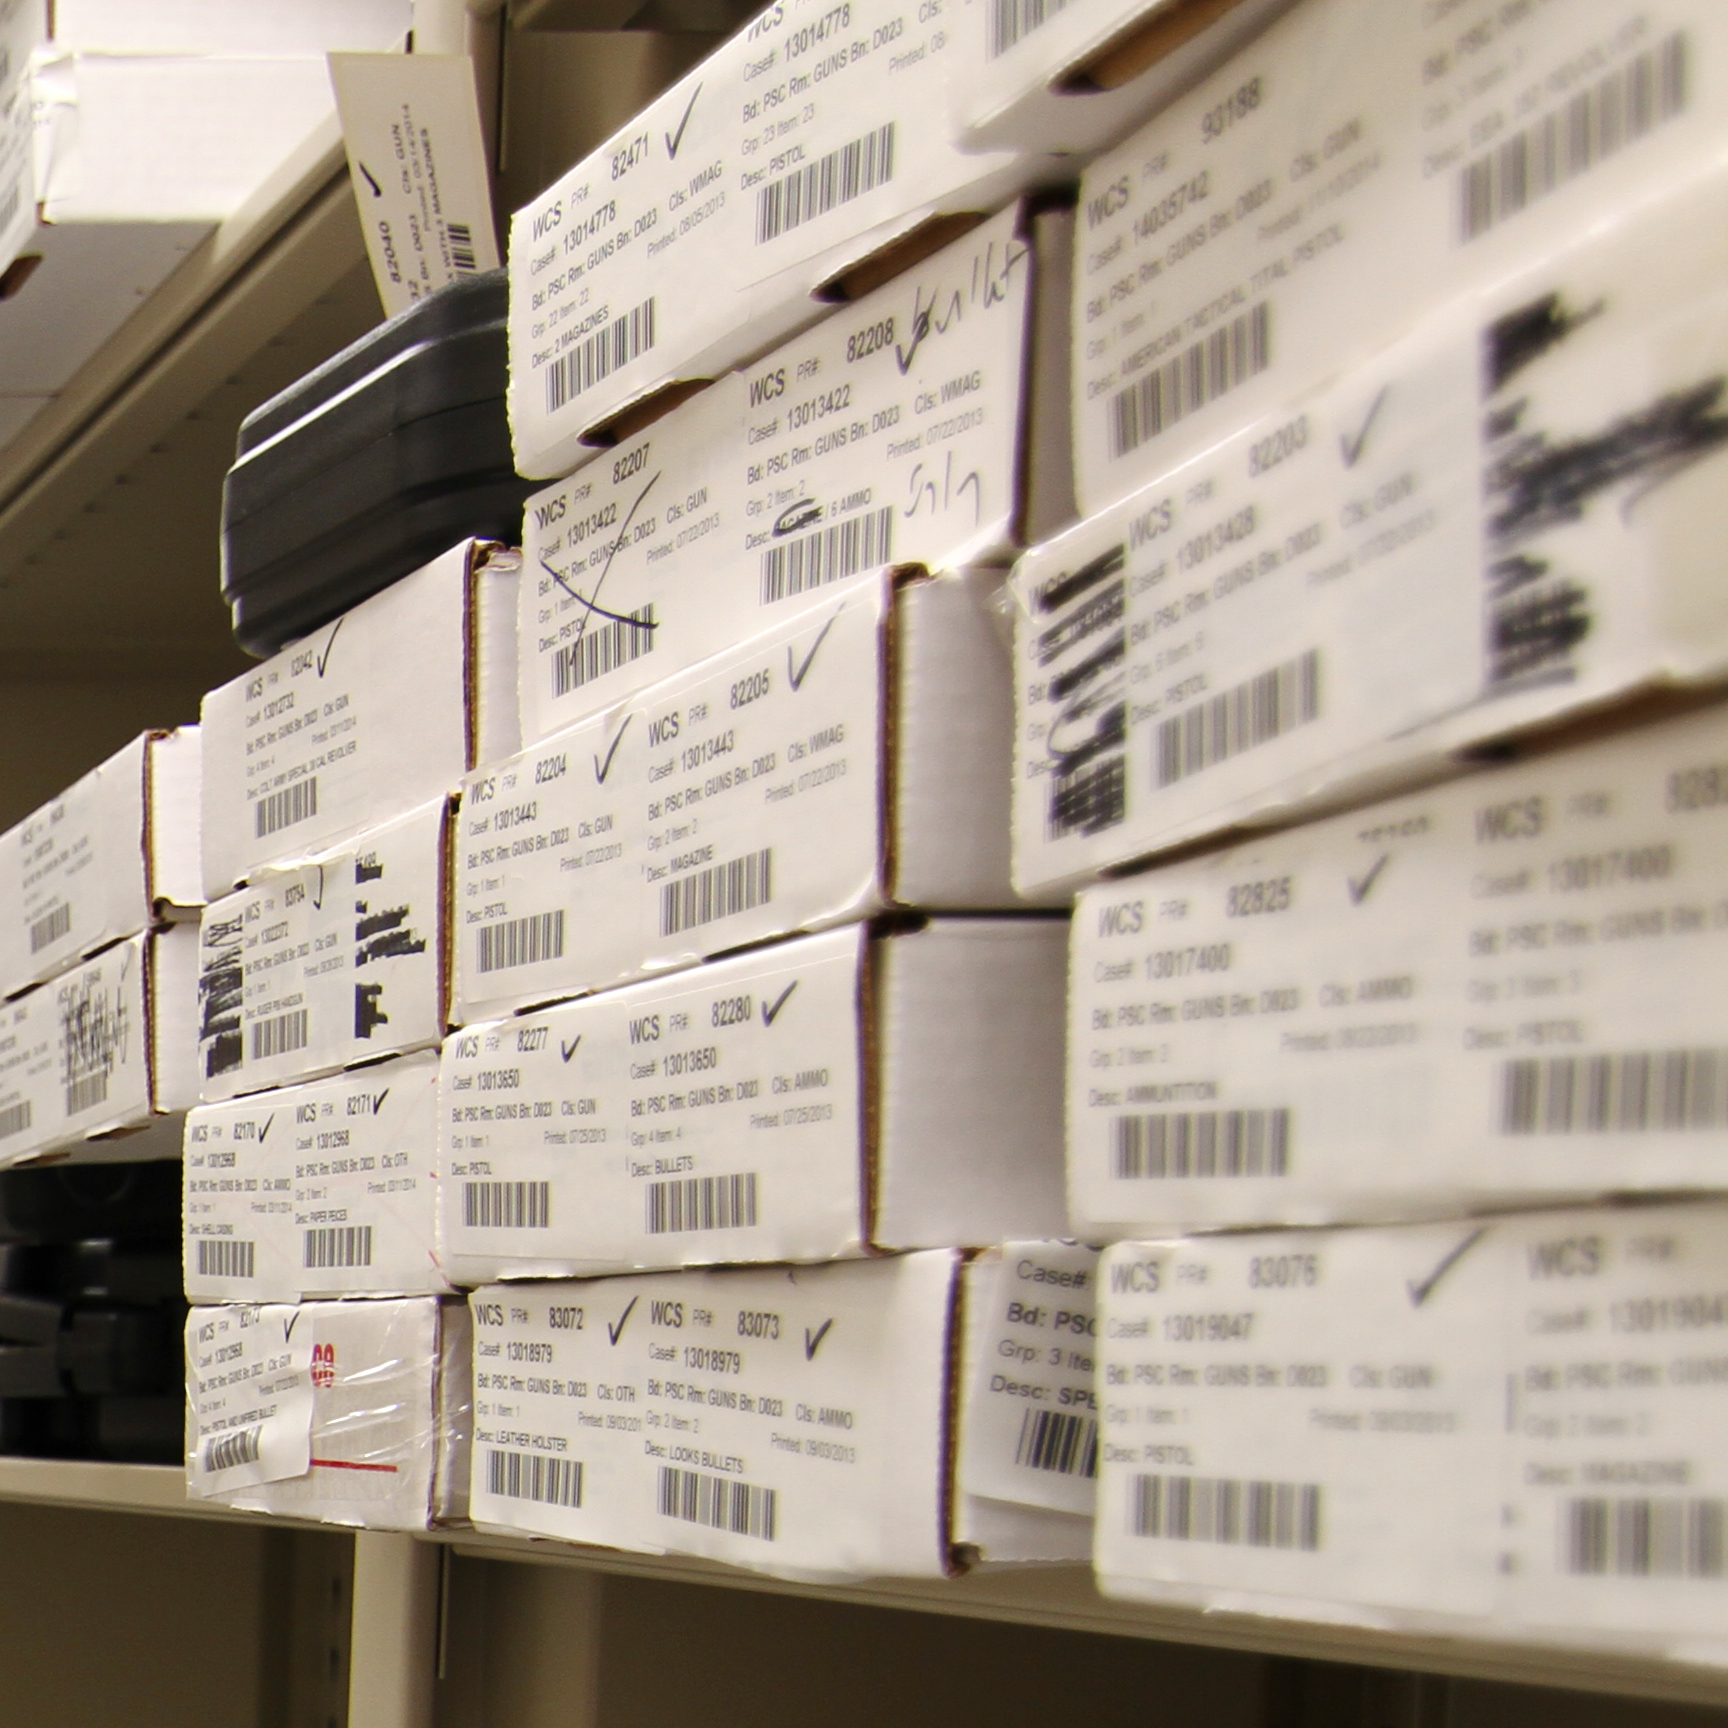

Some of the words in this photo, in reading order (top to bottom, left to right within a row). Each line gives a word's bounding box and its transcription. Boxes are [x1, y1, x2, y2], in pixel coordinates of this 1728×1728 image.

[784, 4, 850, 62] 13014778
[763, 84, 785, 112] PSC
[789, 73, 810, 98] Rm:
[814, 50, 846, 83] GUNS
[851, 40, 868, 63] Bn:
[873, 16, 903, 50] D023
[391, 124, 405, 160] GUN
[769, 144, 806, 176] PISTOL
[420, 128, 441, 215] MAGAZINES
[533, 200, 562, 242] WCS
[611, 132, 648, 181] 82471
[548, 274, 566, 301] PSC
[587, 241, 613, 271] GUNS
[634, 208, 658, 239] D023
[689, 160, 722, 198] WMAG
[563, 200, 616, 255] 13014778
[378, 221, 402, 284] 82040
[561, 305, 609, 349] MAGAZINES
[749, 368, 785, 409] WCS
[846, 317, 894, 364] 82208
[767, 452, 788, 477] PSC
[815, 426, 846, 456] GUNS
[872, 405, 900, 435] D023
[940, 370, 981, 405] WMAG
[787, 384, 850, 432] 13013422
[535, 494, 567, 530] WCS
[613, 442, 650, 485] 82207
[839, 489, 872, 516] AMMO
[567, 503, 617, 549] 13013422
[634, 517, 656, 543] D023
[686, 487, 708, 512] GUN
[648, 711, 679, 748] WCS
[730, 668, 769, 710] 82205
[664, 792, 683, 814] PSC
[705, 772, 732, 797] GUNS
[752, 753, 775, 778] D023
[809, 724, 843, 754] WMAG
[681, 729, 734, 772] 13013443
[471, 778, 495, 805] WCS
[535, 754, 566, 784] 82204
[494, 802, 537, 832] 13013443
[594, 815, 613, 834] GUN
[670, 845, 713, 874] MAGAZINE
[1099, 900, 1144, 938] WCS
[629, 1015, 659, 1045] WCS
[712, 995, 751, 1028] 82280
[456, 1035, 479, 1059] WCS
[517, 1027, 548, 1052] 82277
[663, 1047, 717, 1077] 13013650
[477, 1069, 519, 1091] 13013650
[648, 1096, 666, 1114] PSC
[688, 1087, 716, 1107] GUNS
[794, 1069, 828, 1091] AMMO
[578, 1099, 596, 1114] GUN
[655, 1156, 693, 1174] BULLETS
[1112, 1261, 1160, 1294] WCS
[475, 1304, 503, 1326] WCS
[549, 1307, 583, 1330] 83072
[651, 1300, 682, 1328] WCS
[738, 1310, 779, 1340] 83073
[1007, 1302, 1046, 1327] Bd:
[507, 1342, 552, 1363] 13018979
[684, 1347, 740, 1374] 13018979
[1049, 1348, 1061, 1366] 3
[527, 1378, 550, 1393] GUNS
[616, 1386, 635, 1402] OTH
[665, 1381, 684, 1400] PSC
[708, 1389, 736, 1409] GUNS
[818, 1407, 853, 1430] AMMO
[990, 1375, 1051, 1400] Desc:
[496, 1431, 529, 1446] LEATHER
[532, 1436, 567, 1451] HOLSTER
[670, 1445, 699, 1465] LOOKS
[702, 1452, 743, 1474] BULLETS
